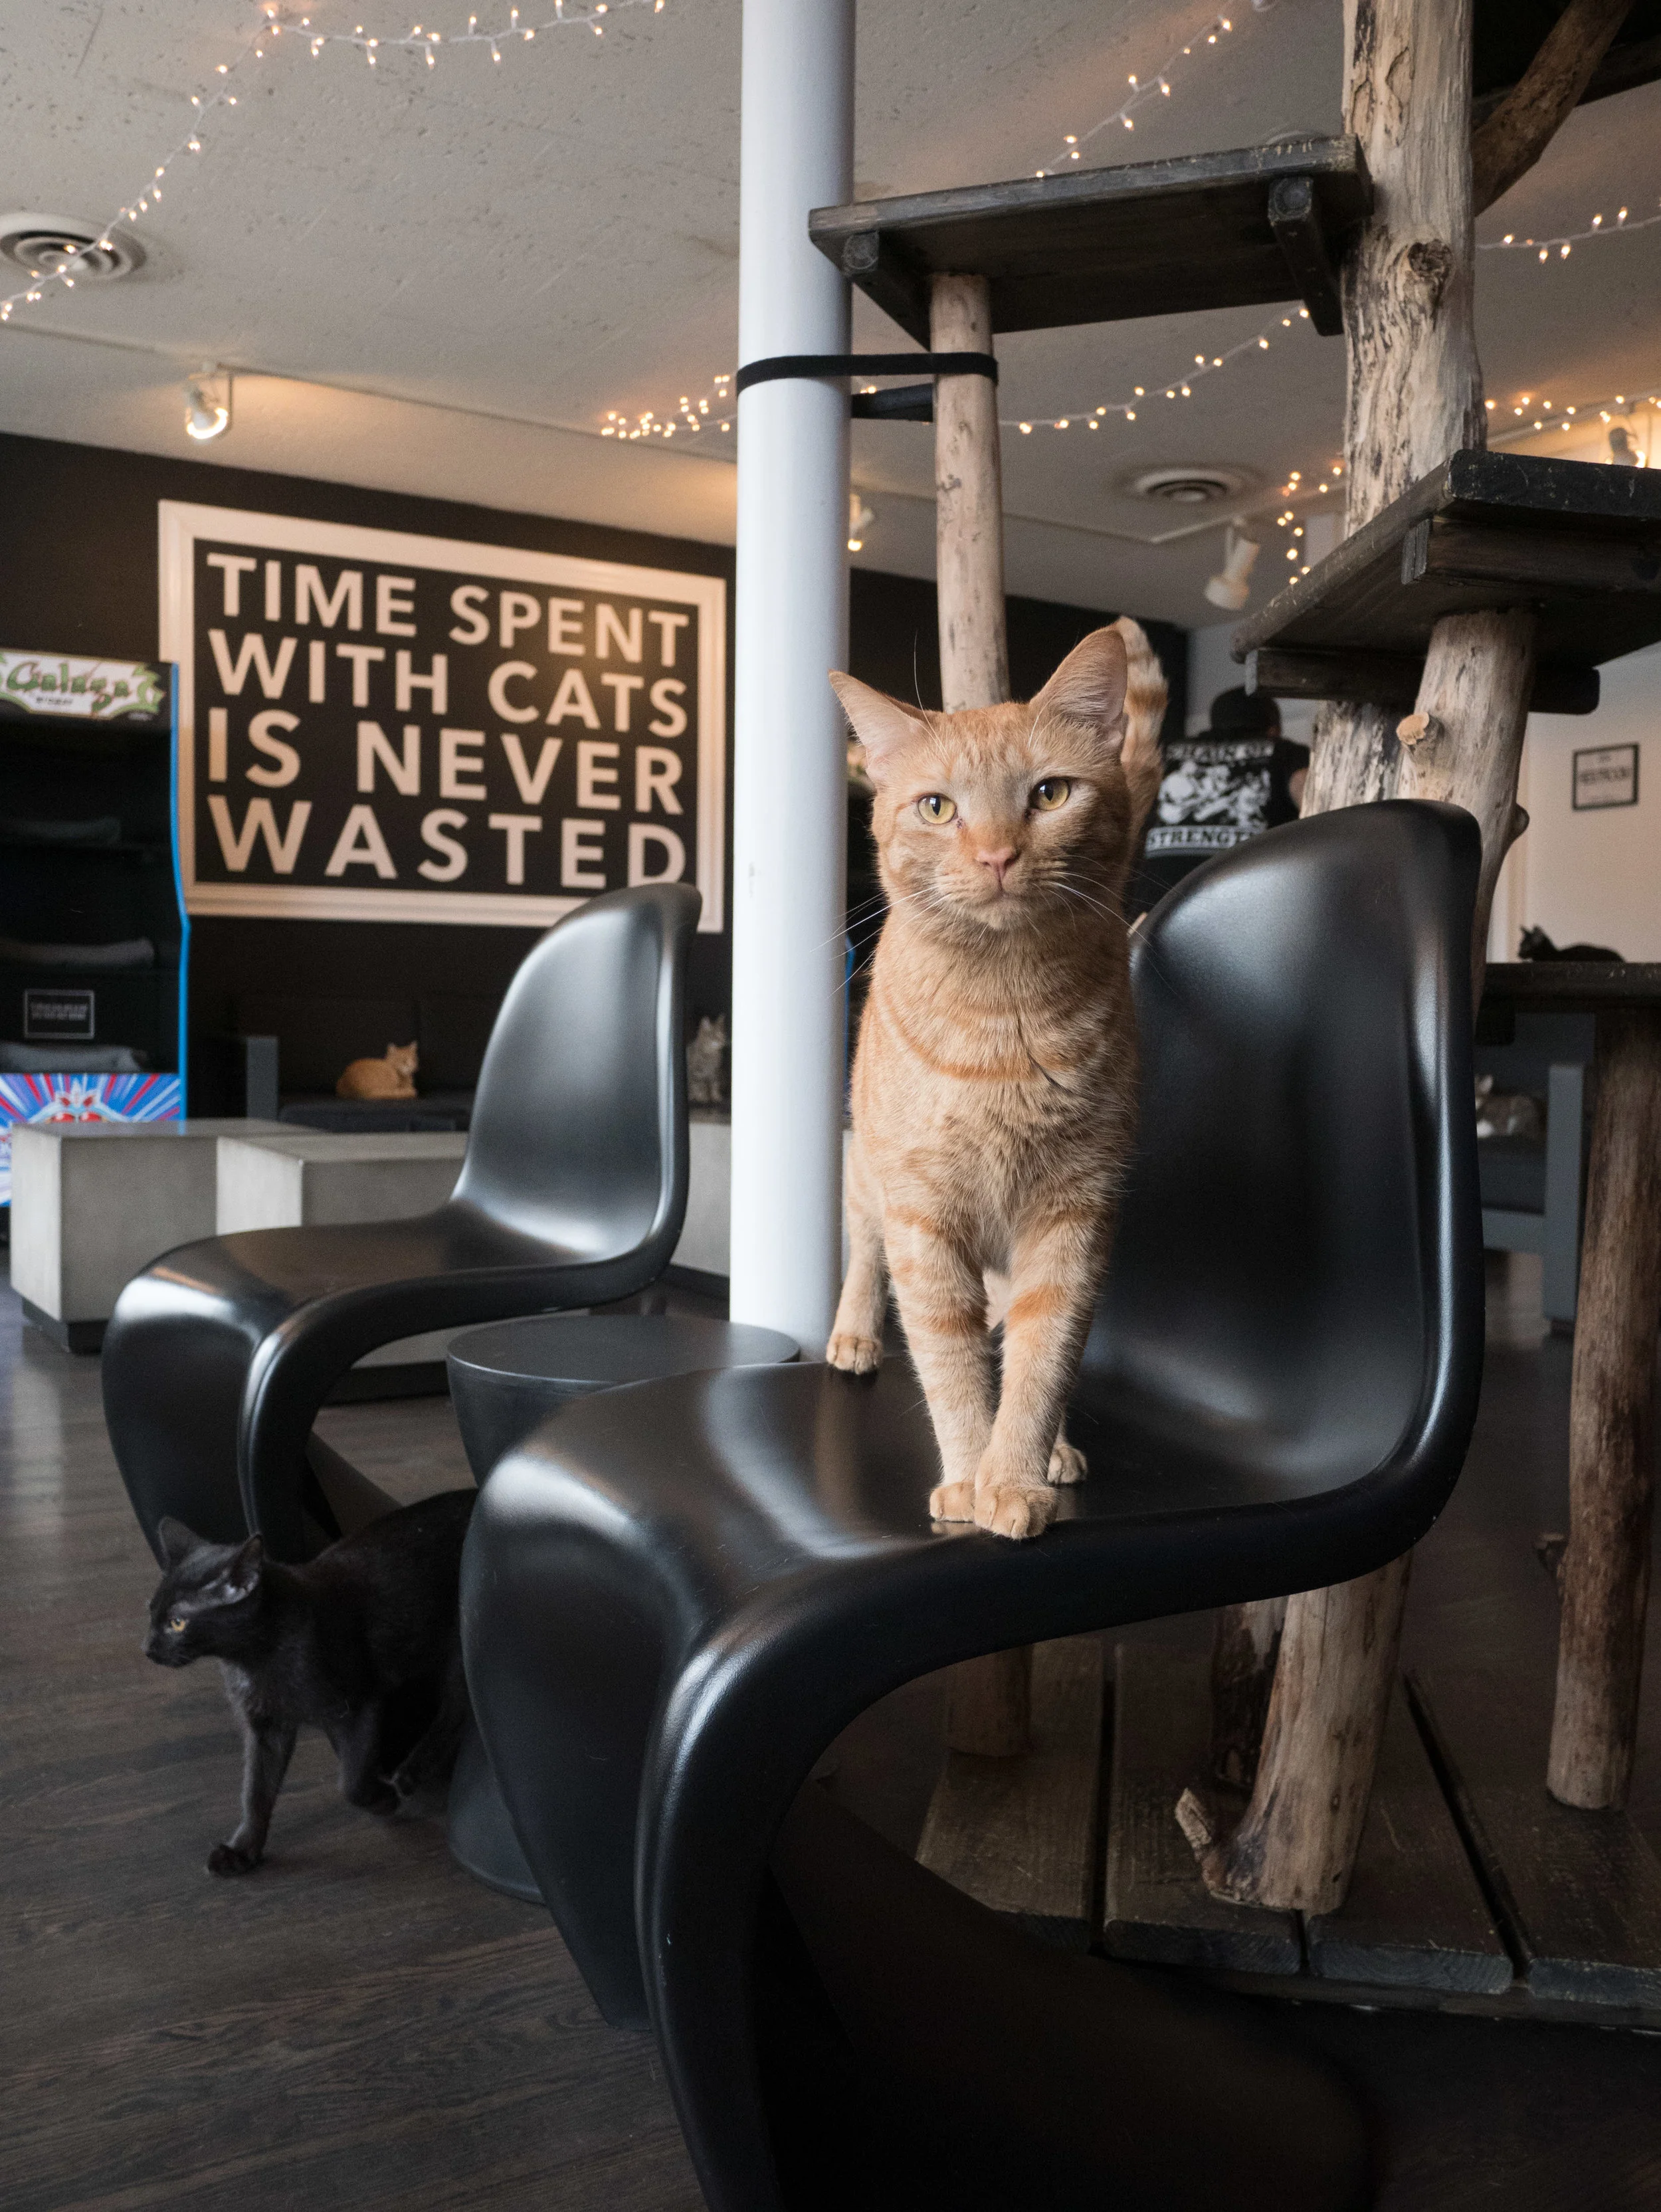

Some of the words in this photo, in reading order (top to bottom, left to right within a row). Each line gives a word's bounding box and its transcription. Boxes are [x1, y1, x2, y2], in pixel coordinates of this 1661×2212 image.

[207, 552, 417, 638] TIME
[449, 585, 690, 667] SPENT
[208, 629, 448, 715] WITH
[488, 661, 688, 738] CATS
[209, 708, 301, 789] IS
[357, 720, 684, 815] NEVER
[207, 795, 687, 890] WASTED
